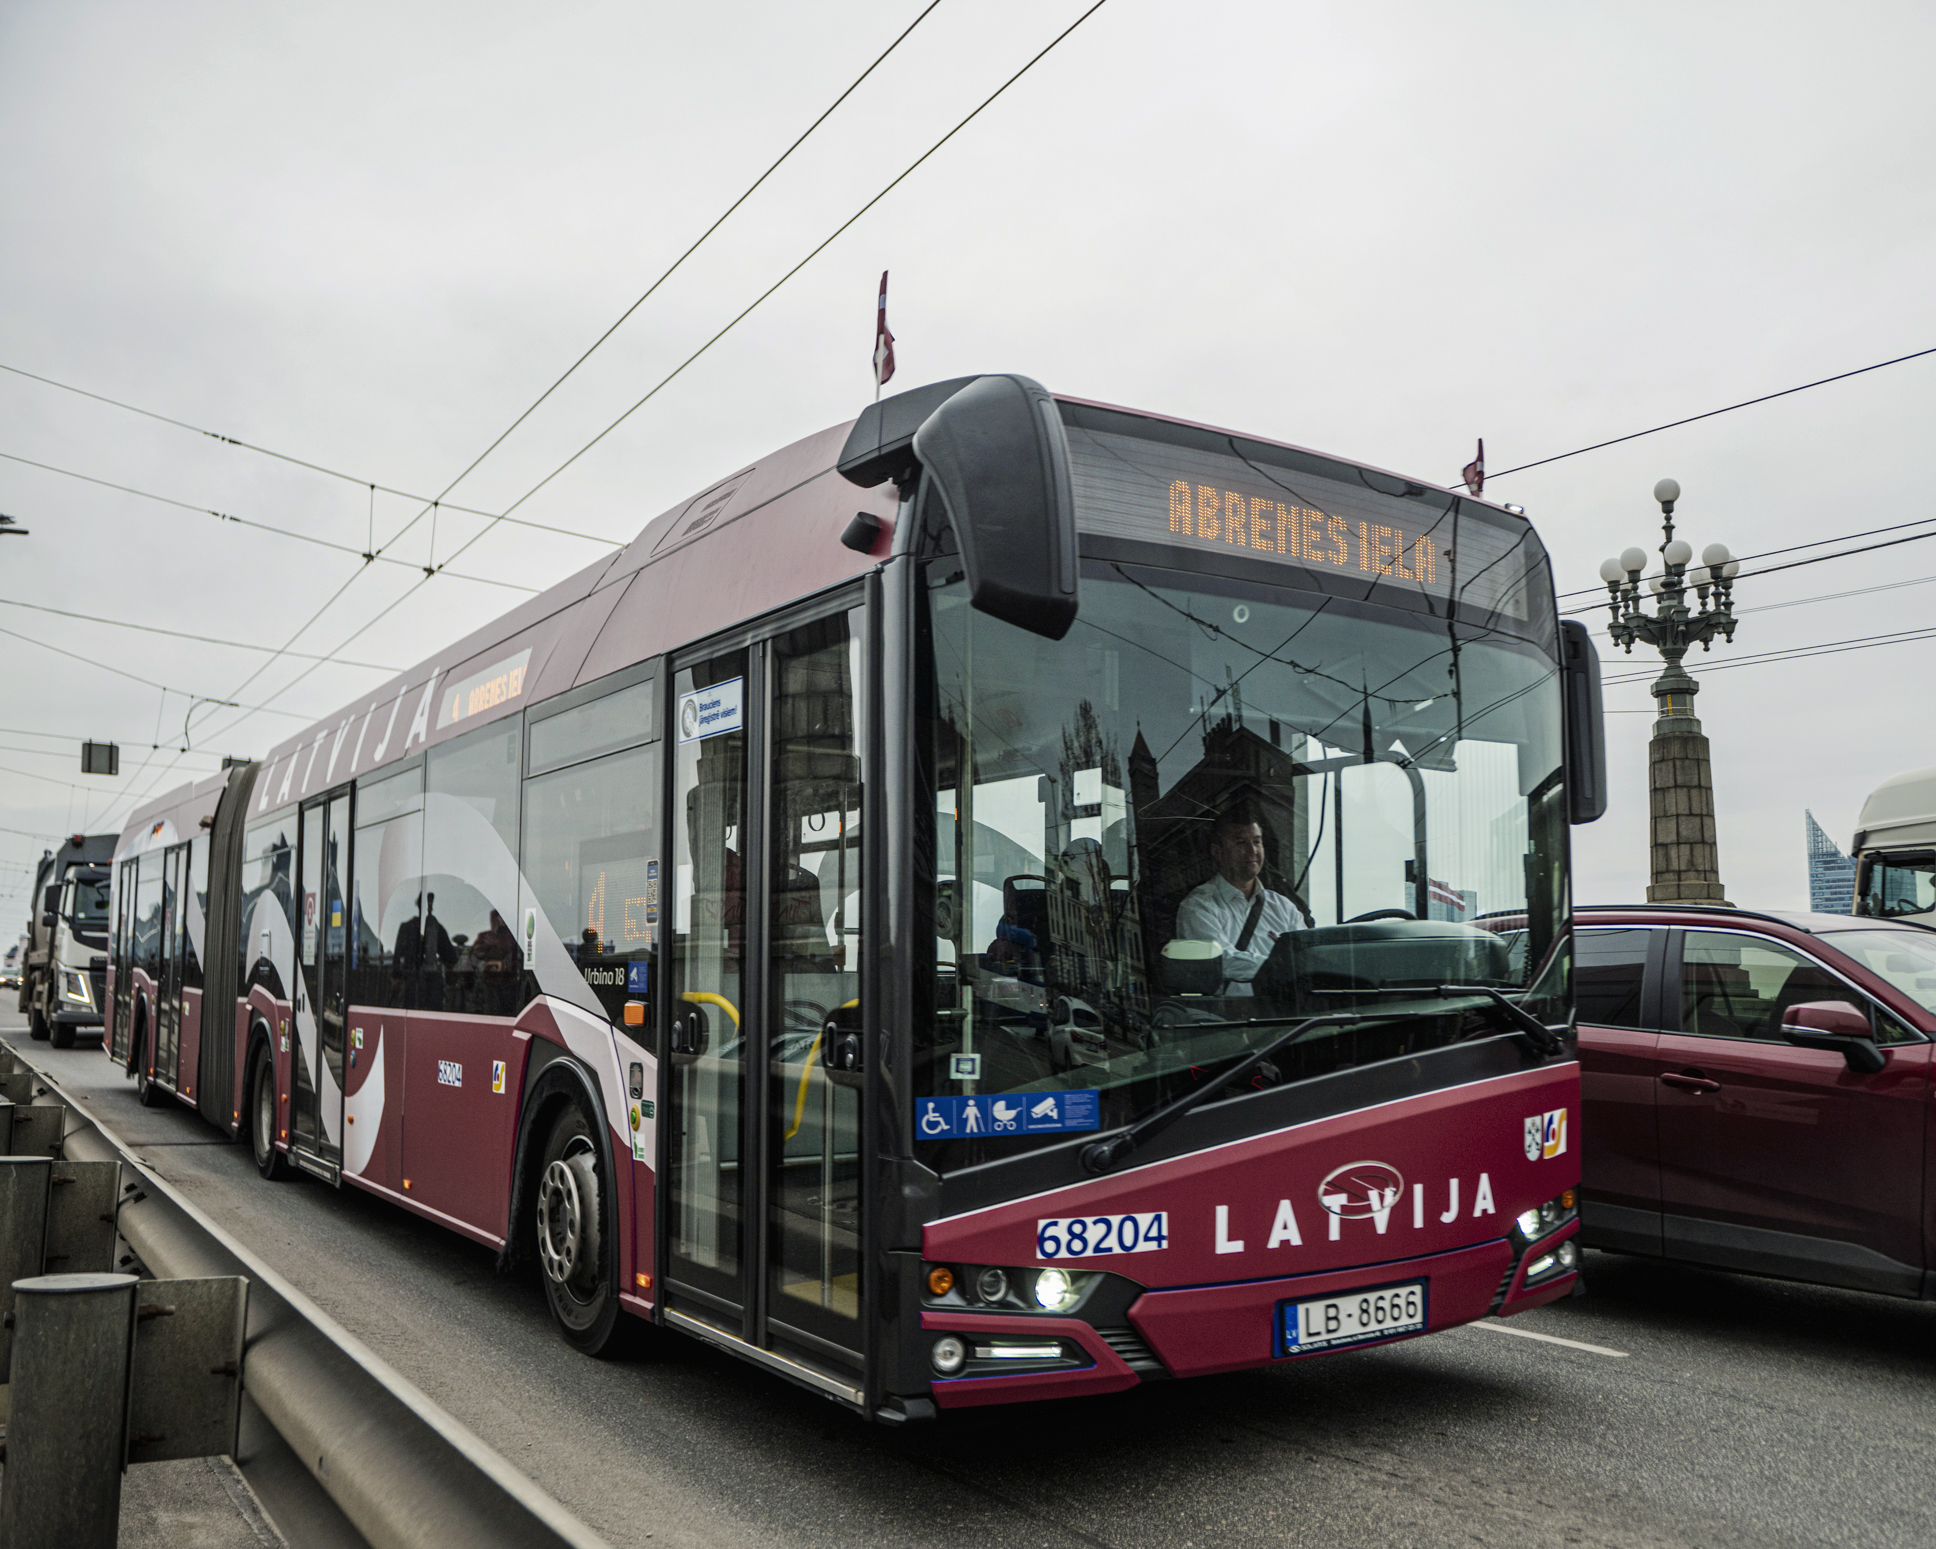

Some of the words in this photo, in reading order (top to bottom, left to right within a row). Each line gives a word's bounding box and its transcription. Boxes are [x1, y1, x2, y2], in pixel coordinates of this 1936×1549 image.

[1169, 479, 1348, 566] ABRENES
[1358, 520, 1436, 584] IELA
[258, 666, 441, 812] LATVIJA
[584, 967, 614, 985] Urbino
[615, 967, 625, 985] 18
[438, 1060, 462, 1086] 68204
[1037, 1212, 1168, 1259] 68204
[1214, 1172, 1497, 1255] LATVIJA
